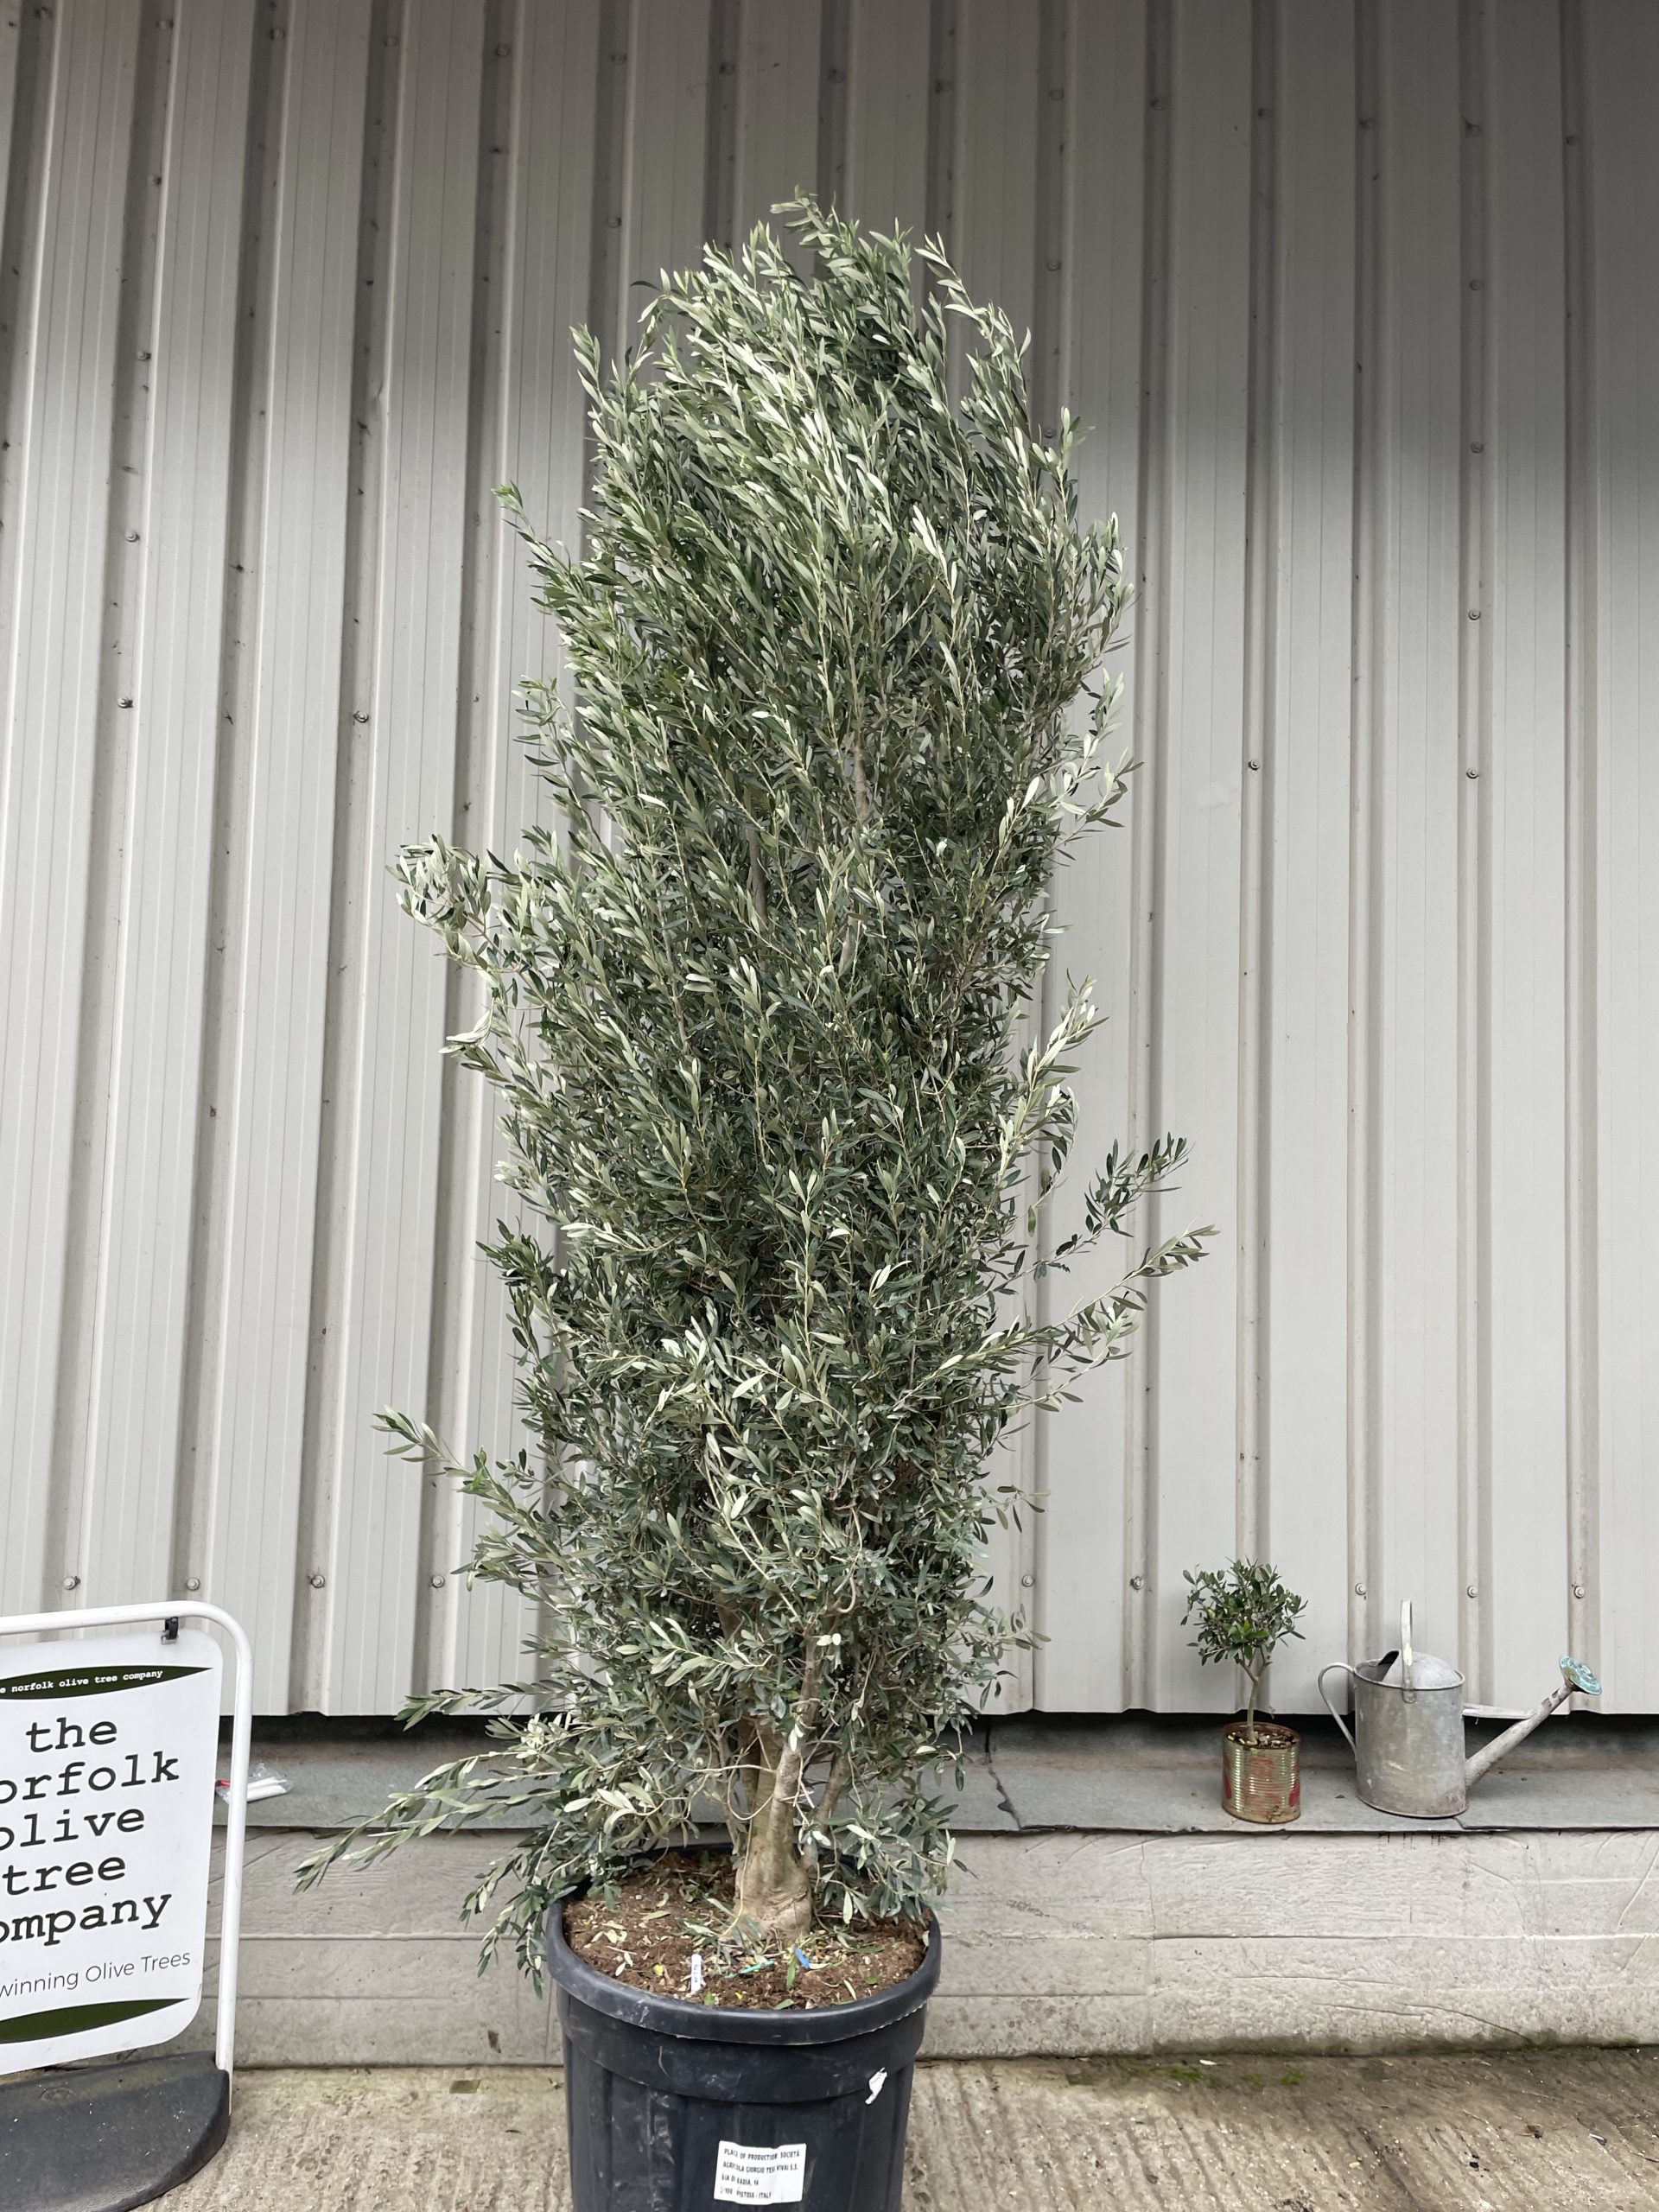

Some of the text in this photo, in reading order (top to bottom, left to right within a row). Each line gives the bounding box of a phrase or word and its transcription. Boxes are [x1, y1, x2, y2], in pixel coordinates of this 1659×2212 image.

[11, 1681, 54, 1693] norfolk
[59, 1677, 89, 1688] olive
[94, 1675, 118, 1684] tree
[123, 1670, 163, 1681] company
[25, 1717, 118, 1752] the
[0, 1751, 180, 1804] orfolk
[2, 1857, 125, 1895] tree
[86, 1961, 135, 1982] Olive
[141, 1952, 191, 1973] Trees
